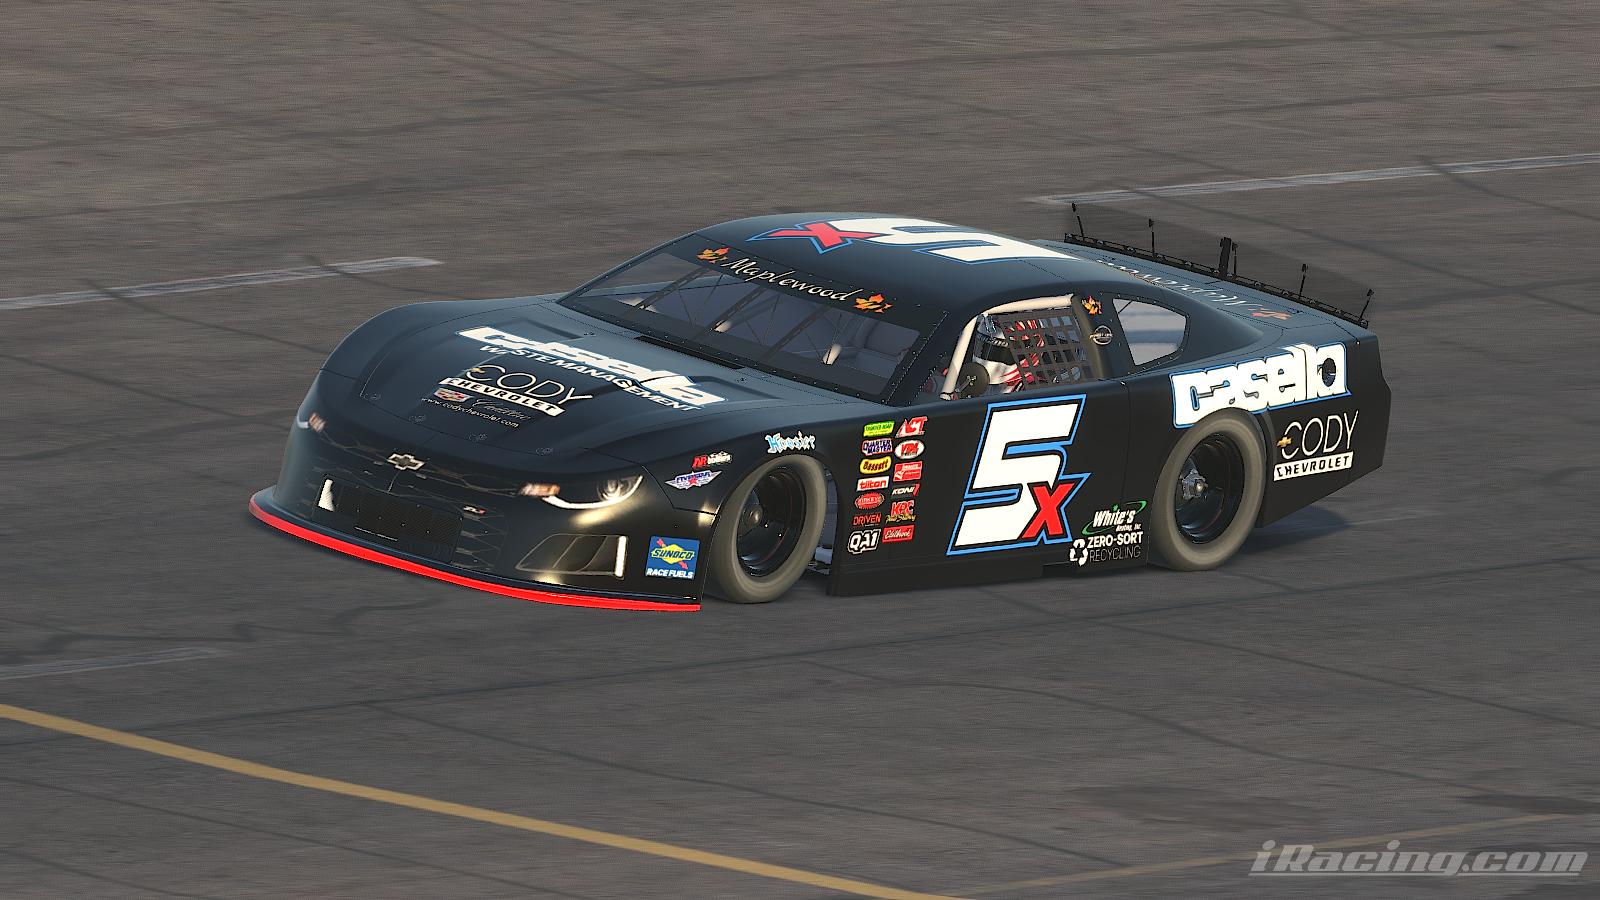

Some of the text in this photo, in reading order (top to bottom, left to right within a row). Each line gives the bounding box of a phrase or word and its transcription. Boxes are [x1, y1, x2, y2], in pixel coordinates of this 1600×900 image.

[721, 258, 864, 302] Maplewood
[456, 326, 727, 406] casella
[449, 378, 558, 412] CHEVROLET
[466, 364, 593, 406] CODY
[550, 359, 704, 411] MANAGEMENT
[1170, 344, 1350, 428] casella
[765, 431, 815, 453] Hoosier
[864, 440, 890, 450] QUARTER
[1281, 411, 1358, 460] CODY
[868, 445, 892, 454] MASTER
[1276, 455, 1350, 477] CHEVROLET
[860, 480, 886, 489] tilton
[892, 485, 916, 495] KONI
[853, 513, 881, 526] DRIVEN
[1093, 508, 1136, 527] White's
[849, 530, 879, 552] QA1
[1087, 531, 1143, 548] ZERO-SORT
[653, 549, 692, 559] SUNOCO
[1090, 545, 1141, 562] RECYCLING
[646, 567, 694, 579] RACE FUELS
